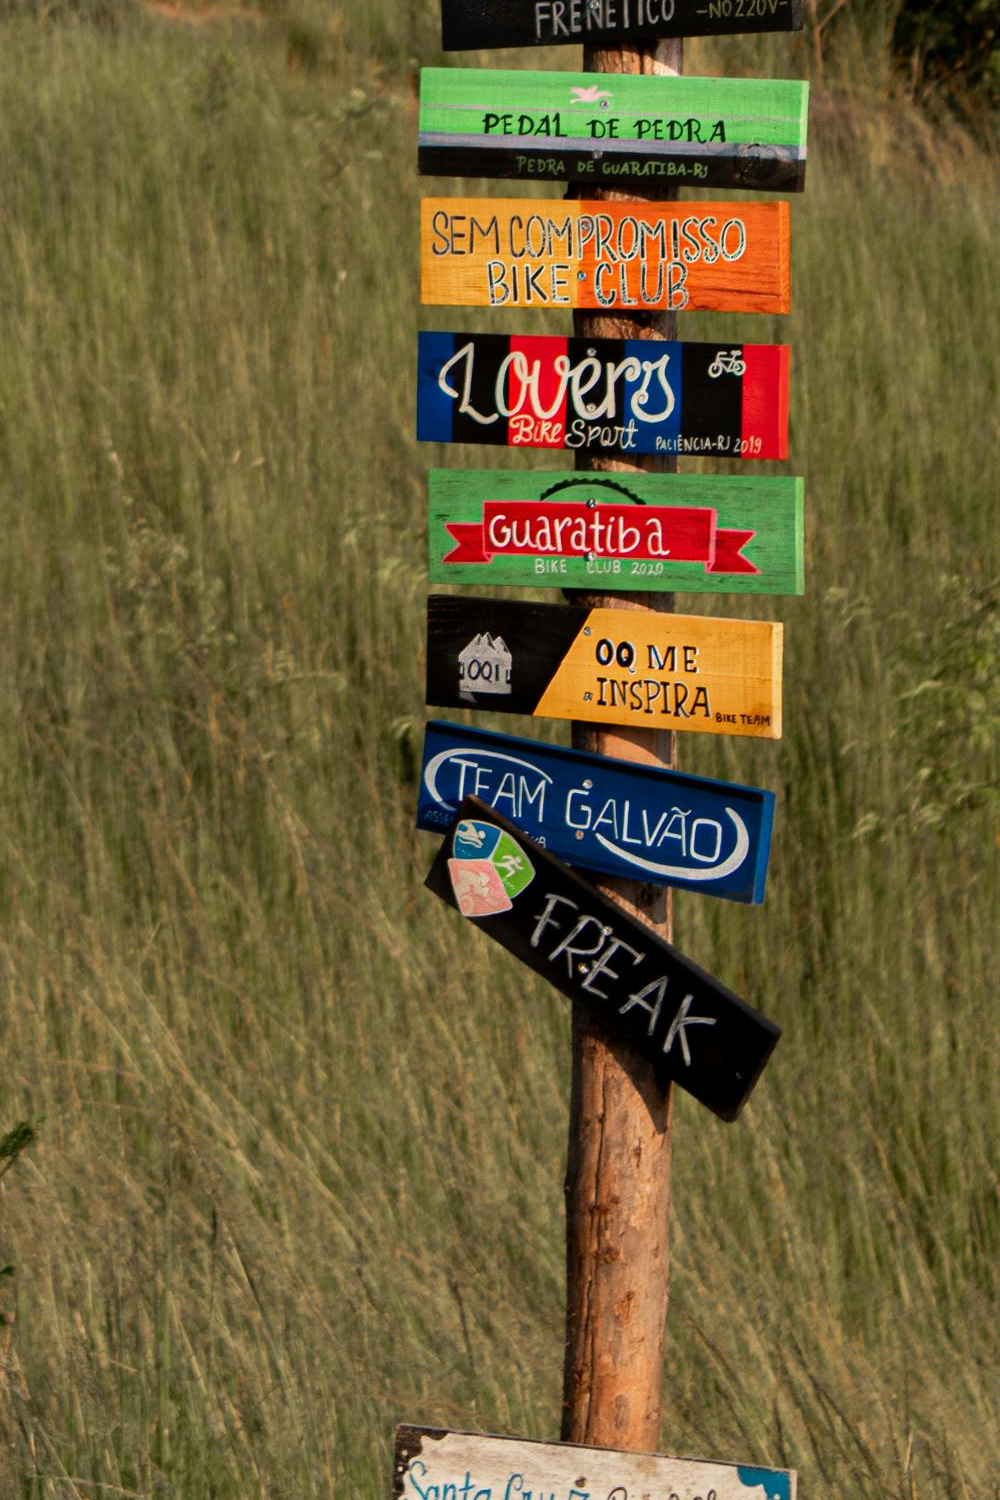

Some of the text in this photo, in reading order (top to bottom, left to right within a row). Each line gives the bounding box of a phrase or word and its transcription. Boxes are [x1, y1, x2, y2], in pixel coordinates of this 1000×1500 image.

[482, 112, 727, 145] PEDAL DE PEDRA
[516, 155, 565, 175] PEDRA
[577, 160, 595, 173] DE
[432, 210, 747, 264] SEM COMPROMISSO
[486, 261, 690, 311] BIKE CLUB
[437, 342, 675, 425] Lovers
[733, 435, 762, 453] 2019
[489, 511, 670, 556] Guaratiba
[535, 558, 664, 576] BIKE CLUB 2020
[595, 638, 700, 674] OQ ME
[595, 676, 712, 719] INSPIRA
[715, 712, 770, 726] BIKE TEAM
[449, 757, 722, 863] TEAM GALVÃO
[530, 892, 717, 1068] FREAK
